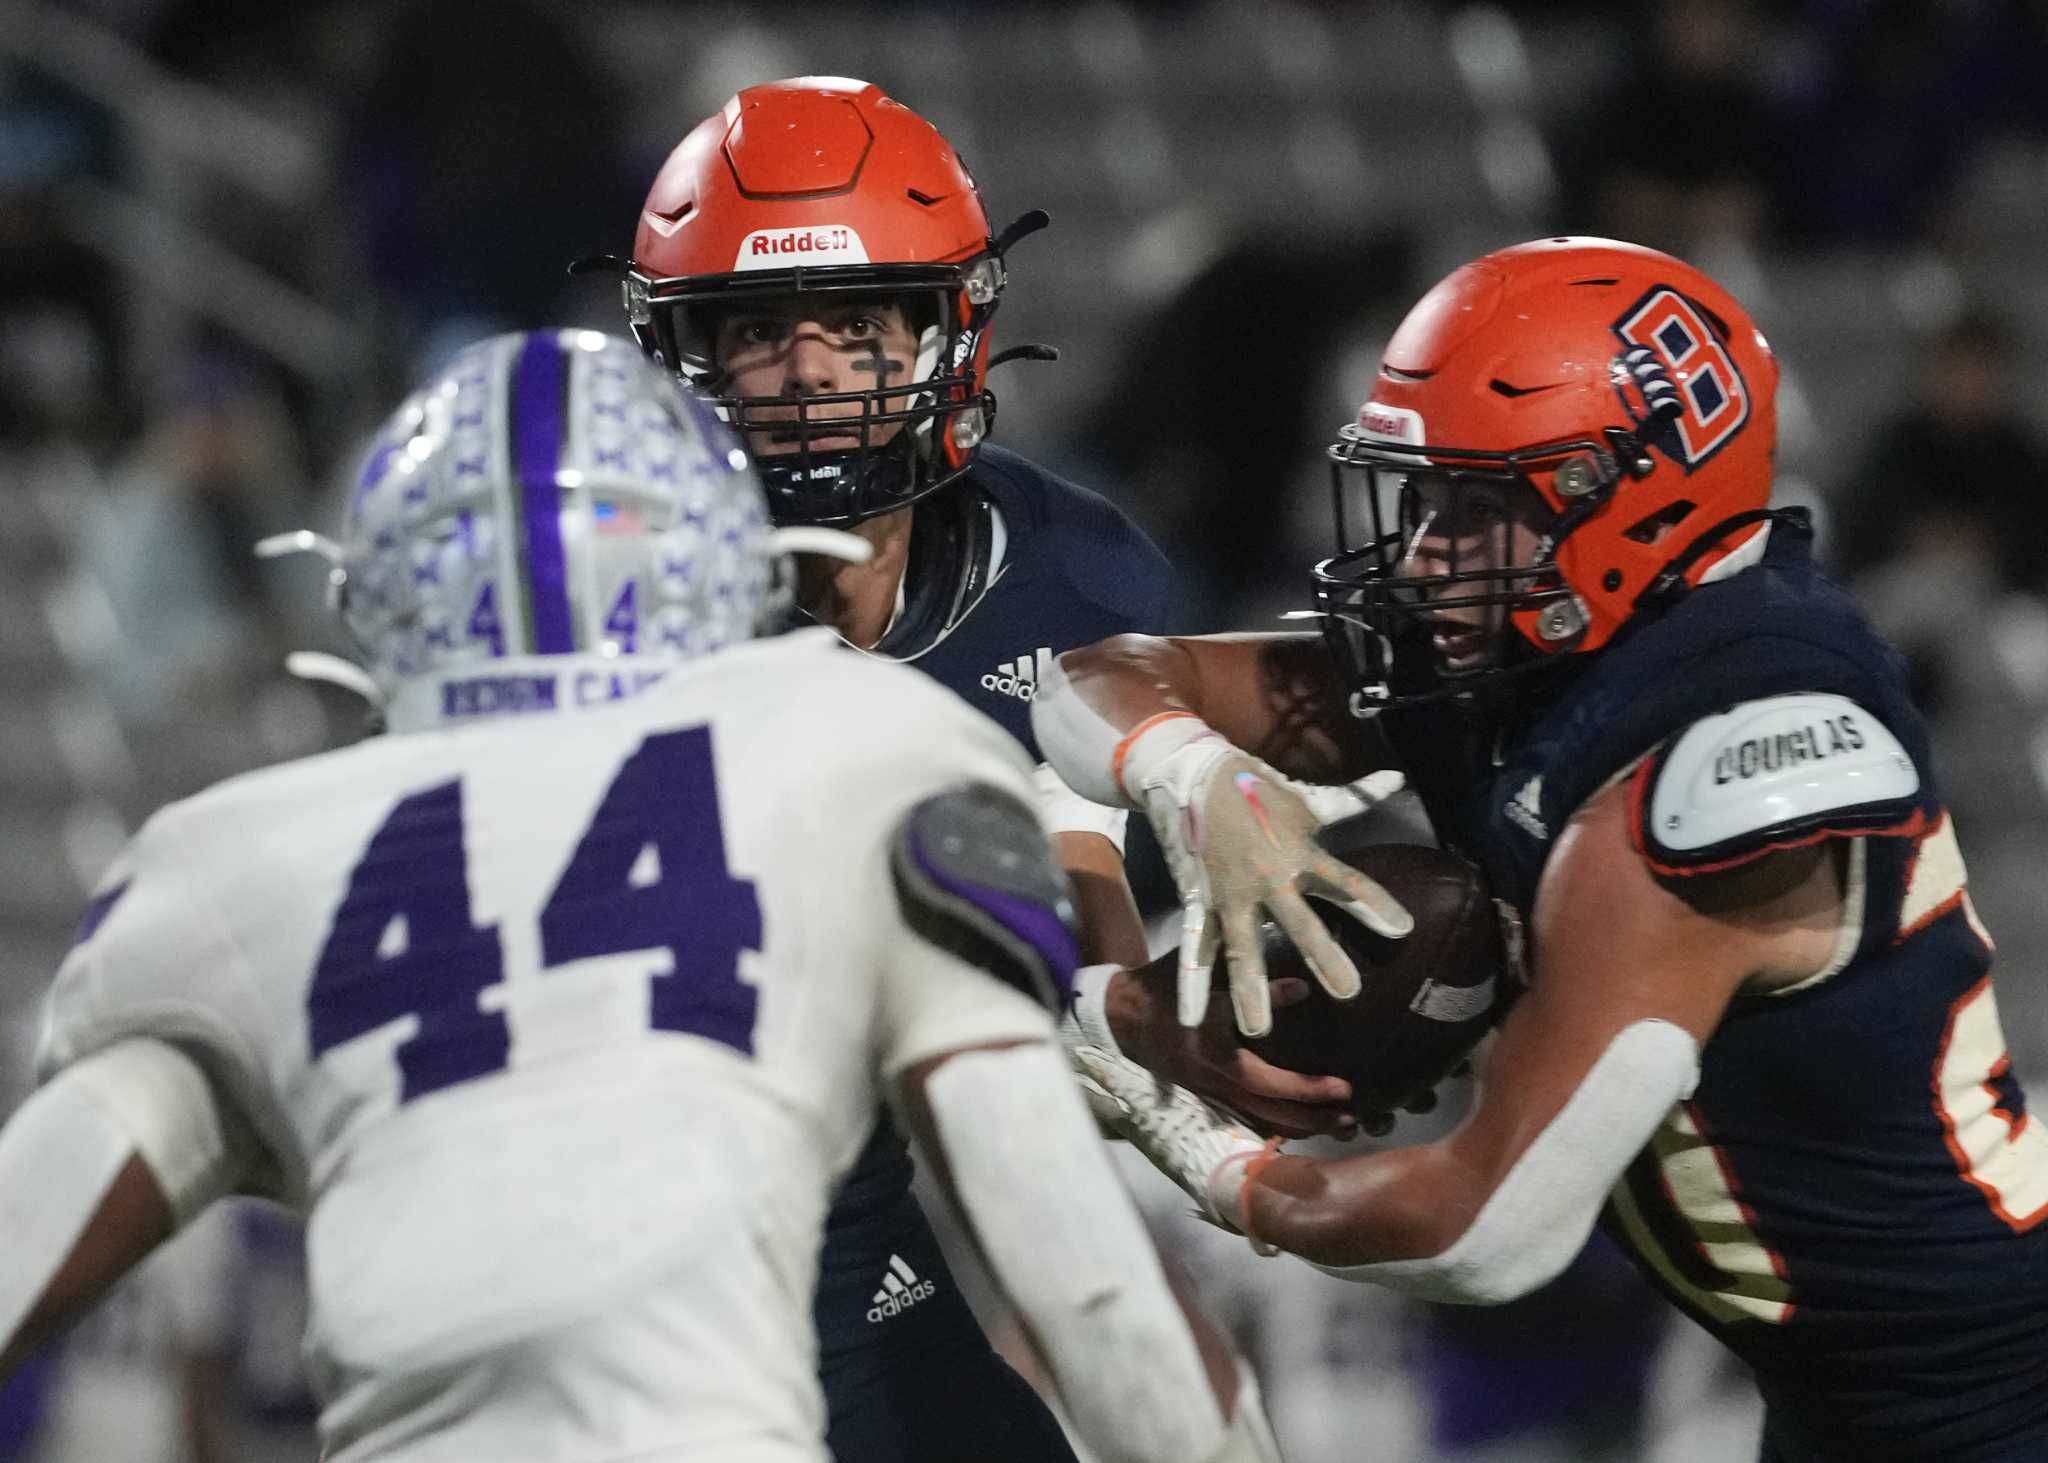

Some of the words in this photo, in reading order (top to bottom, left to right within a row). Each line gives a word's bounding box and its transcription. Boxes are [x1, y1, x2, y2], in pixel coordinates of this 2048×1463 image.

[751, 230, 848, 255] Riddell
[1612, 285, 1751, 474] B
[791, 465, 841, 482] Rdell
[468, 582, 507, 657] 4
[605, 576, 638, 654] 4
[981, 673, 1040, 702] adid
[1713, 714, 1866, 786] DOUGLAS
[306, 722, 764, 1107] 44
[866, 1279, 936, 1323] adidas
